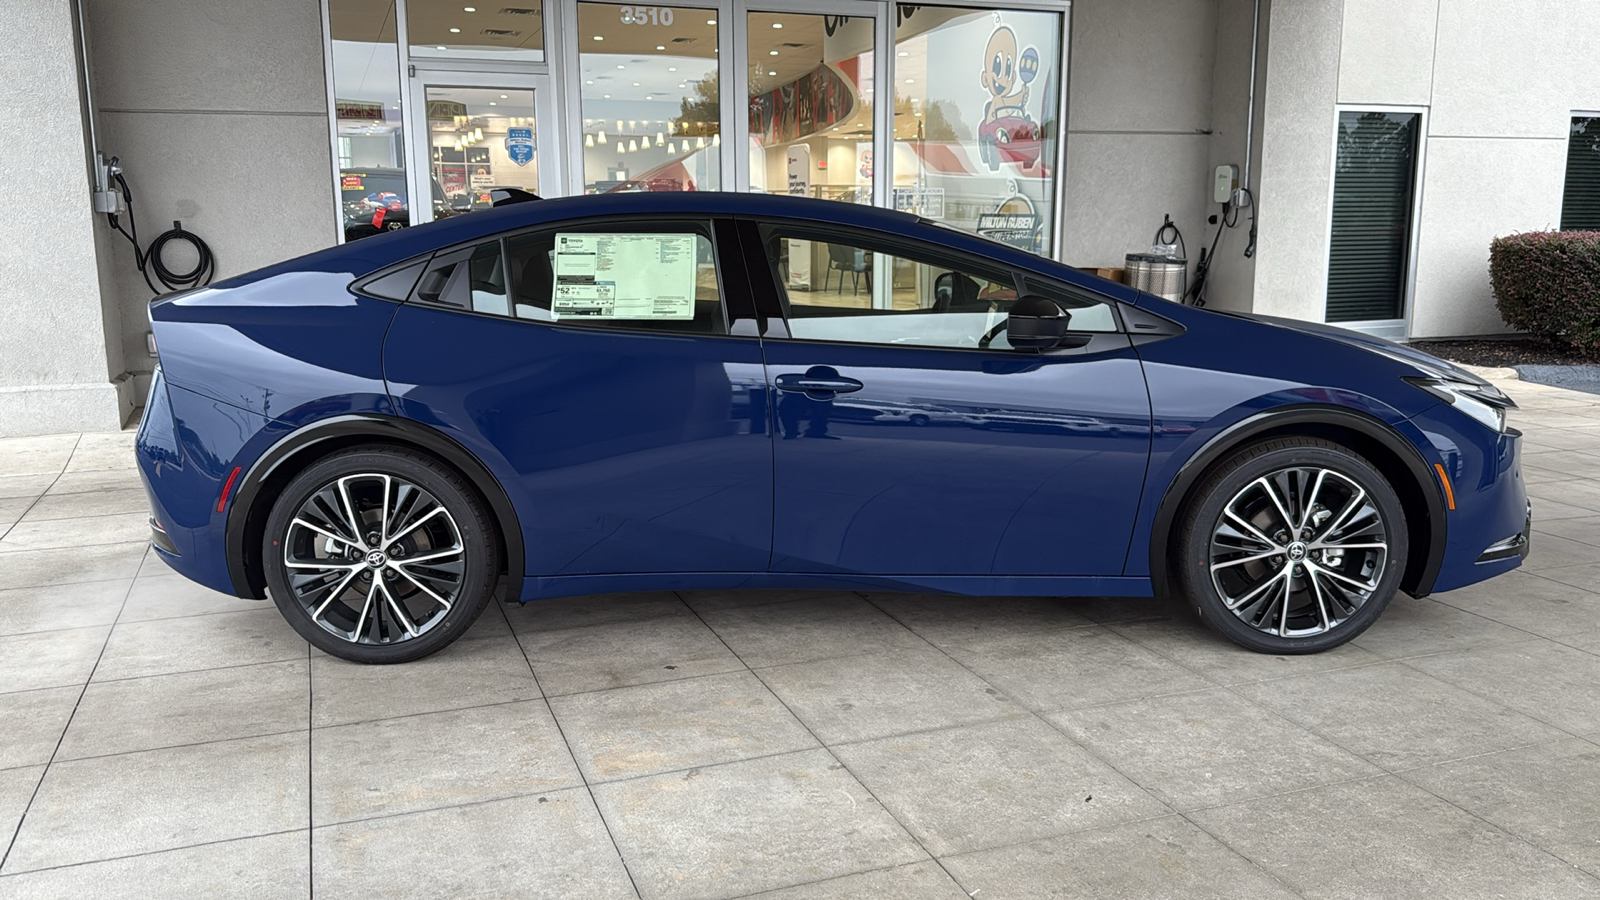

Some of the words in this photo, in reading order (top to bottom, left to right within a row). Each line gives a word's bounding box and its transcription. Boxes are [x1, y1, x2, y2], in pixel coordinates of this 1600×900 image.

[620, 6, 673, 26] 3510
[981, 216, 1008, 228] MILTON
[1007, 216, 1035, 229] RUBEN
